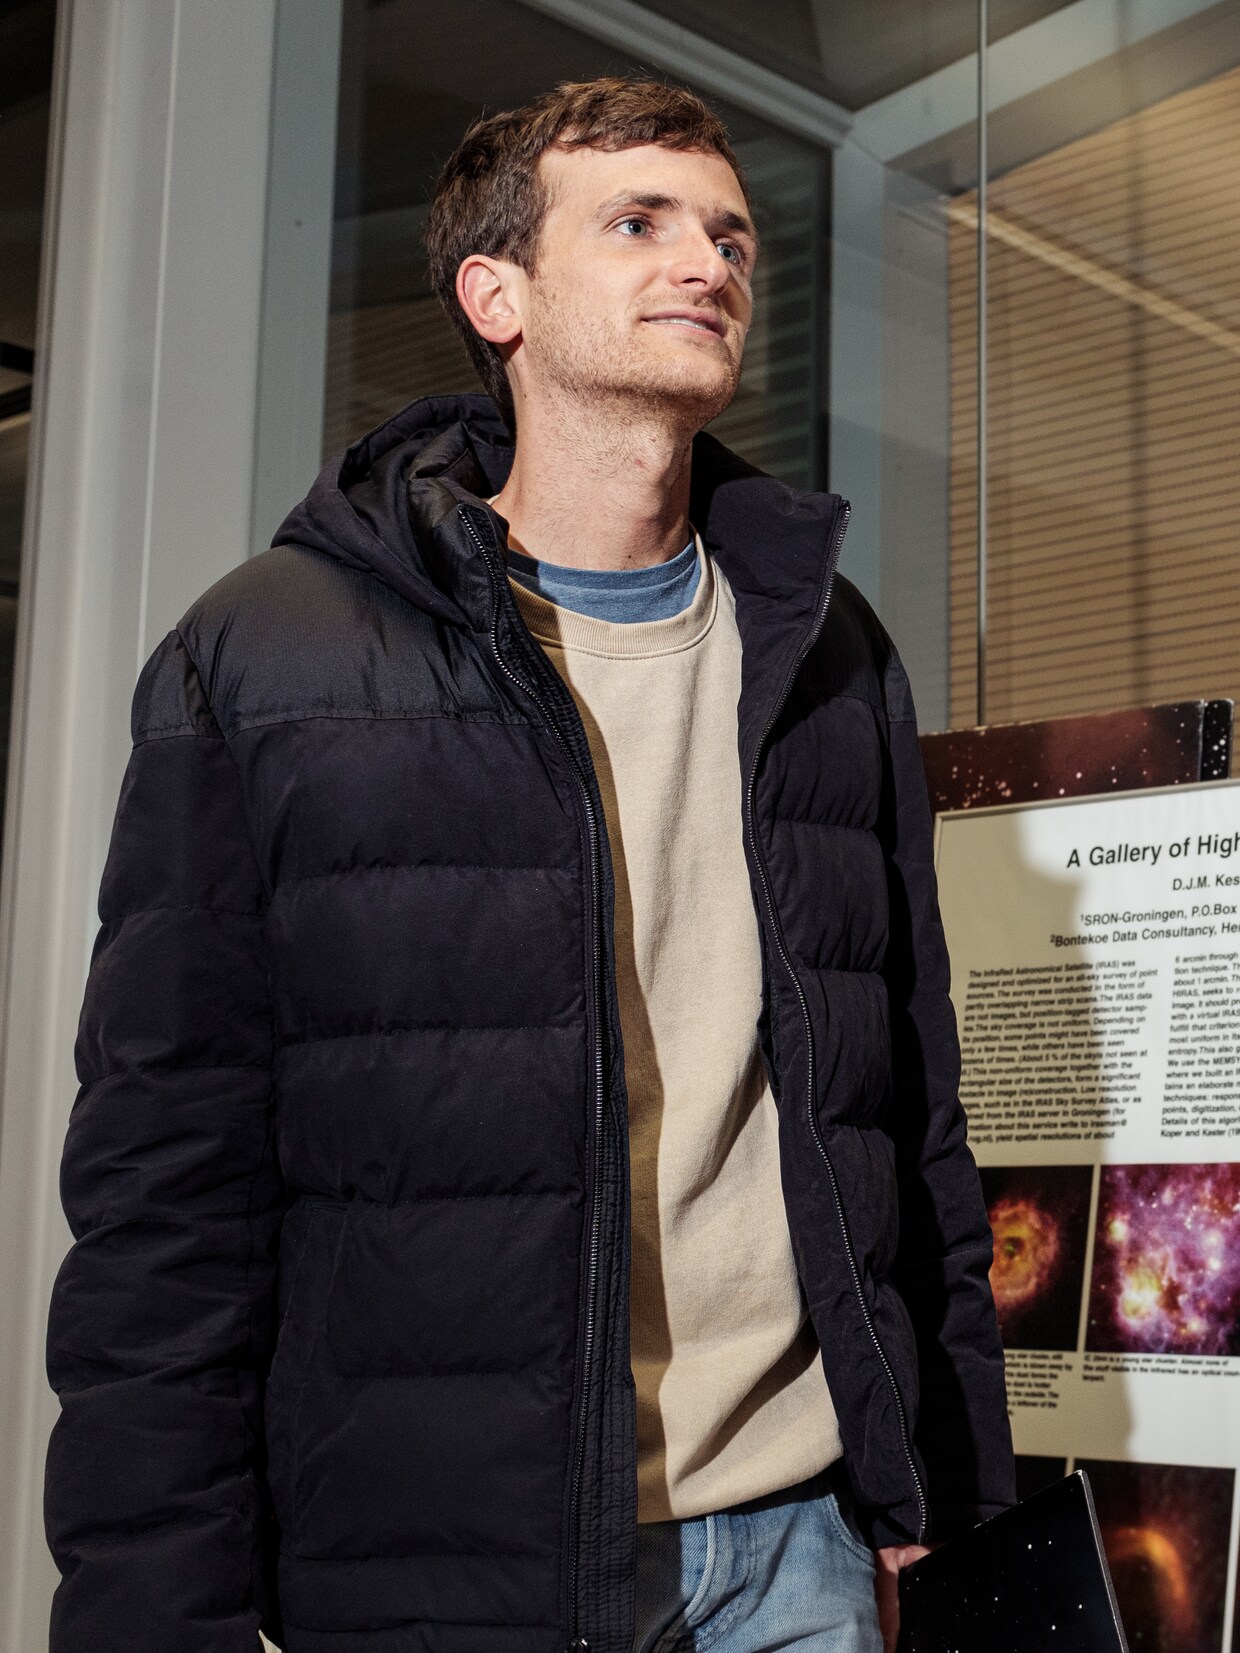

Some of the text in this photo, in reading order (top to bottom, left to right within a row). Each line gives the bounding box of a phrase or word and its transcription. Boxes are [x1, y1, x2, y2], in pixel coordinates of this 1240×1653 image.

[1066, 848, 1080, 868] A
[1089, 843, 1161, 866] Gallery
[1168, 837, 1190, 857] of
[1172, 875, 1209, 890] D.J.M.
[1112, 930, 1137, 942] Data
[1141, 925, 1216, 939] Consultancy,
